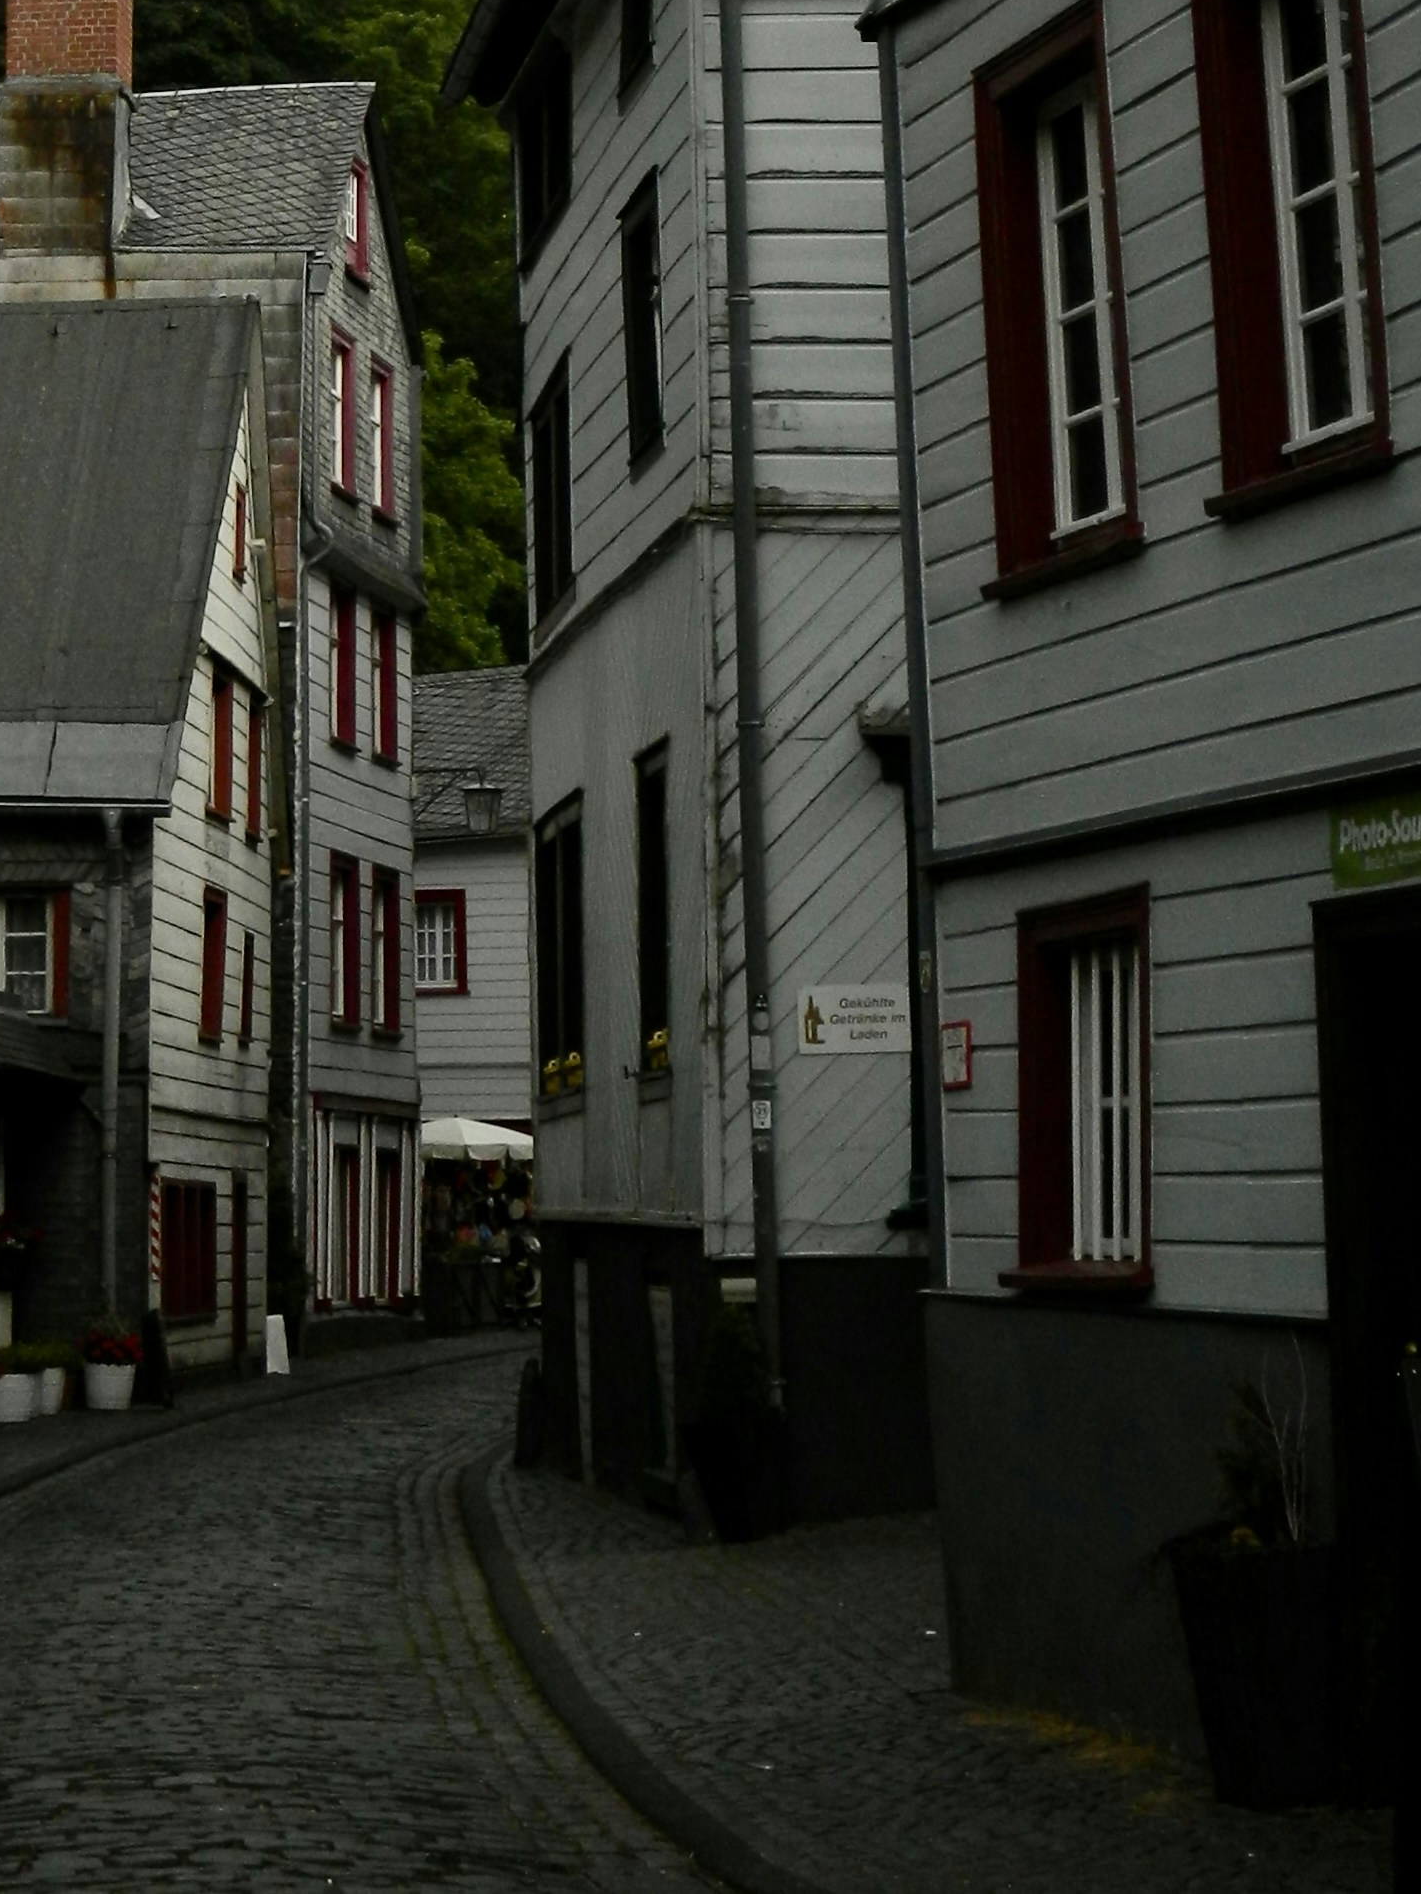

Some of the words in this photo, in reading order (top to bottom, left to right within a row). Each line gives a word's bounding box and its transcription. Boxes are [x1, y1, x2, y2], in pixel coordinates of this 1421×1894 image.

[839, 996, 896, 1009] Gekühlte
[830, 1012, 887, 1025] Getränke
[891, 1013, 907, 1025] im
[849, 1028, 888, 1040] Laden
